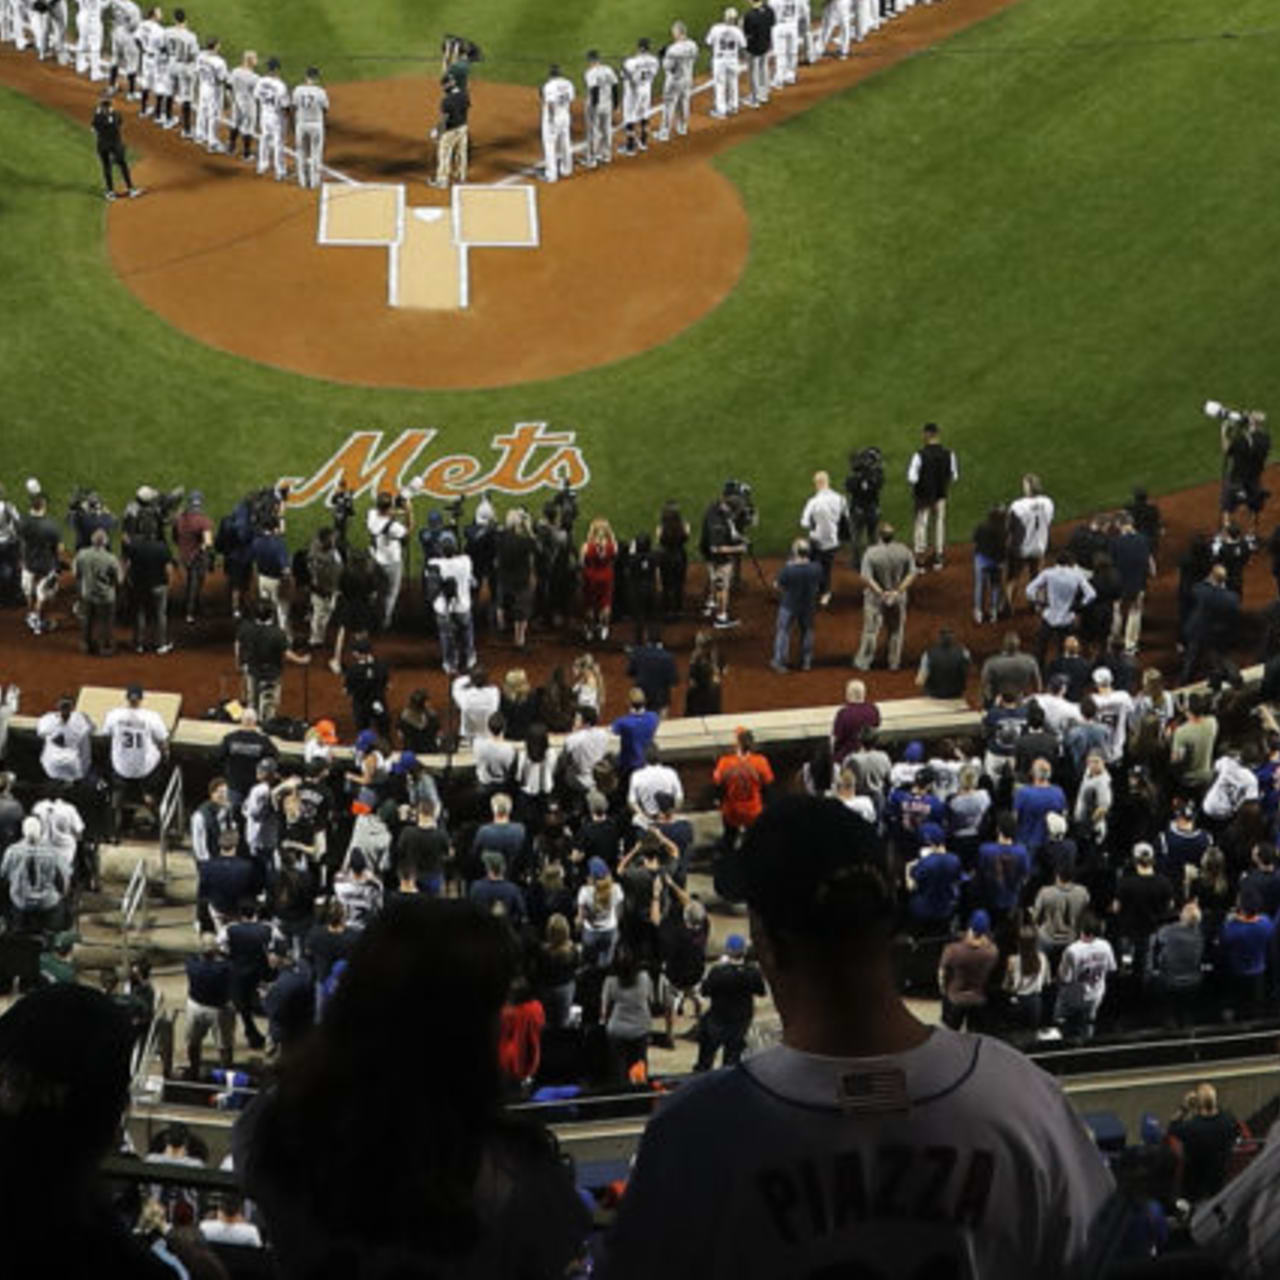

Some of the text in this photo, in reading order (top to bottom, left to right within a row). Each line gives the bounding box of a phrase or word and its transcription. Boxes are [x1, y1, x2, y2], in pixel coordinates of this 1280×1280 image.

[275, 422, 591, 509] Mets
[122, 730, 144, 750] 31
[756, 1145, 996, 1244] PIAZZA
